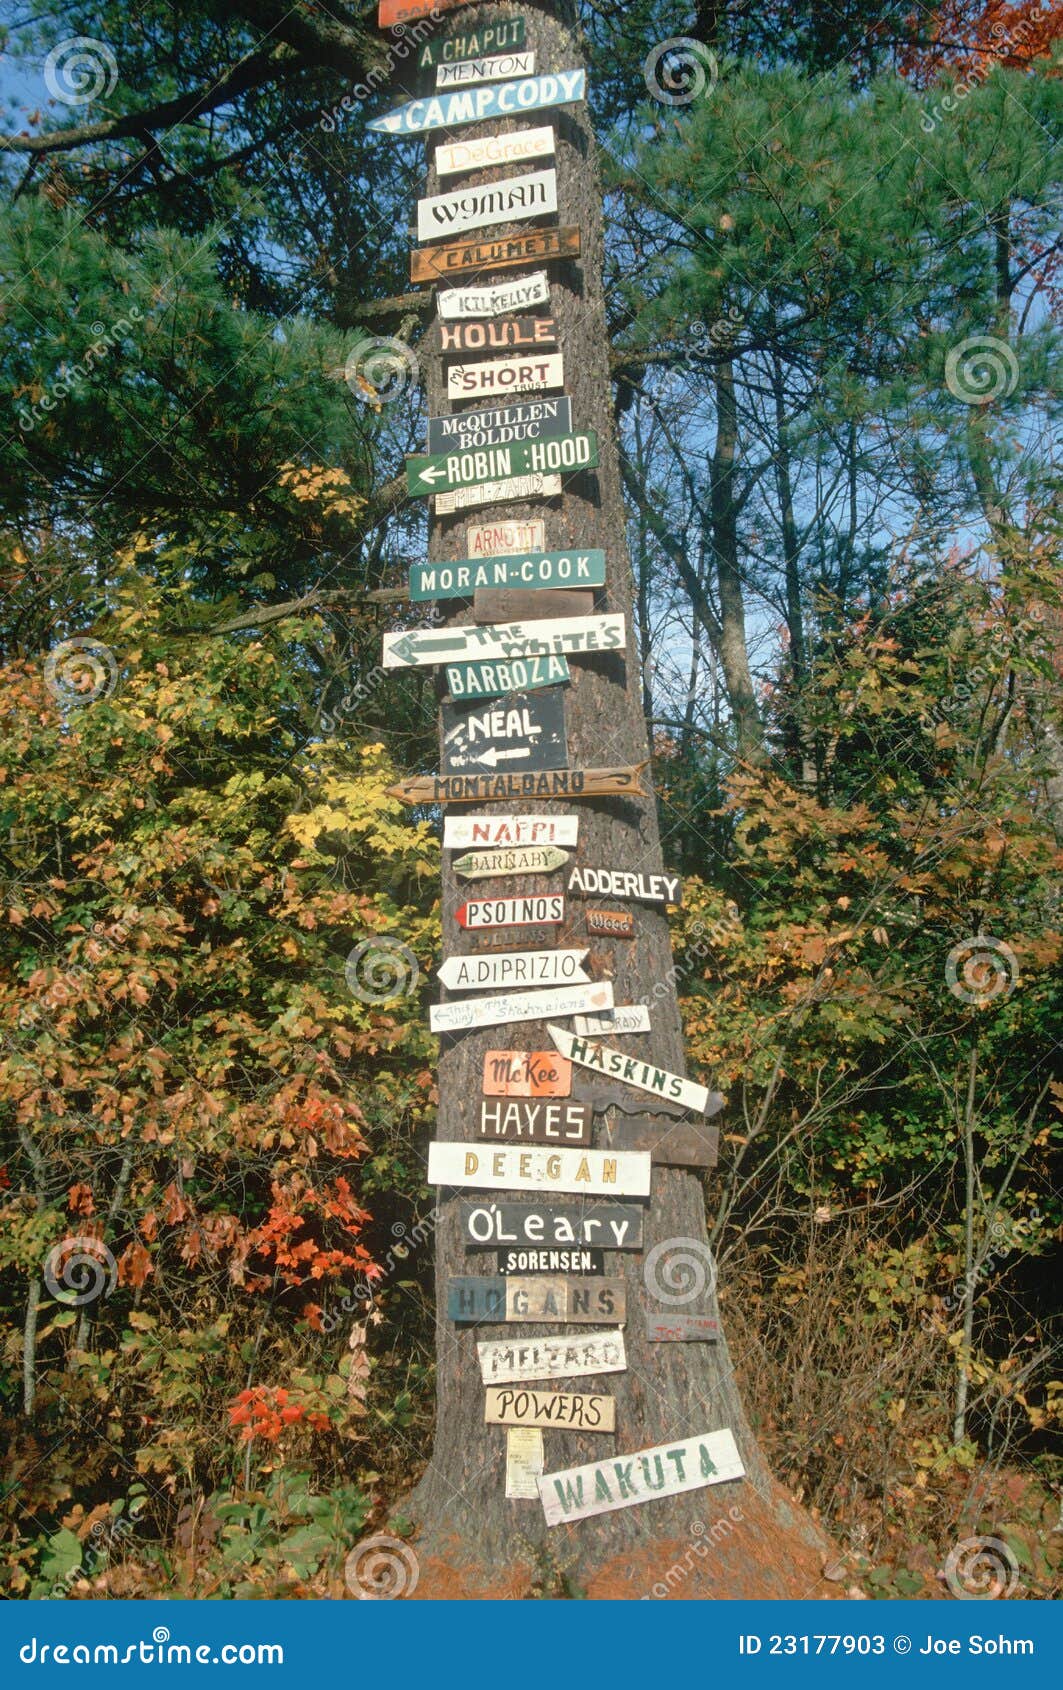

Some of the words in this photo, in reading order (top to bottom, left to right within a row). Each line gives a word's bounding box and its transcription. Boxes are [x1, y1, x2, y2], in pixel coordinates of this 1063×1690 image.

[443, 20, 521, 61] CHAPUT
[440, 57, 529, 84] MENTON
[444, 138, 546, 169] DeGrace
[447, 236, 553, 268] CALUMET
[441, 320, 555, 349] HOULE
[463, 364, 550, 391] SHORT
[512, 381, 549, 392] TRUST
[441, 401, 558, 436] McQUILLEN
[459, 422, 540, 449] BOLDUC
[447, 448, 511, 483] ROBIN
[474, 526, 537, 552] ARNOTT
[421, 557, 591, 592] MORAN-COOK
[448, 657, 566, 695] BARBOZA
[468, 709, 542, 741] NEAL
[470, 850, 550, 871] BARNABY
[568, 867, 678, 901] ADDERLEY
[468, 898, 562, 925] PSOINOS
[490, 1058, 560, 1088] McKee
[570, 1037, 683, 1097] HASKINS
[481, 1101, 585, 1139] HAYES
[465, 1152, 617, 1184] DEEGAN
[468, 1204, 629, 1246] O'Leary
[458, 1289, 615, 1315] HOGANS
[497, 1390, 602, 1426] POWERS
[553, 1443, 718, 1515] WAKUTA
